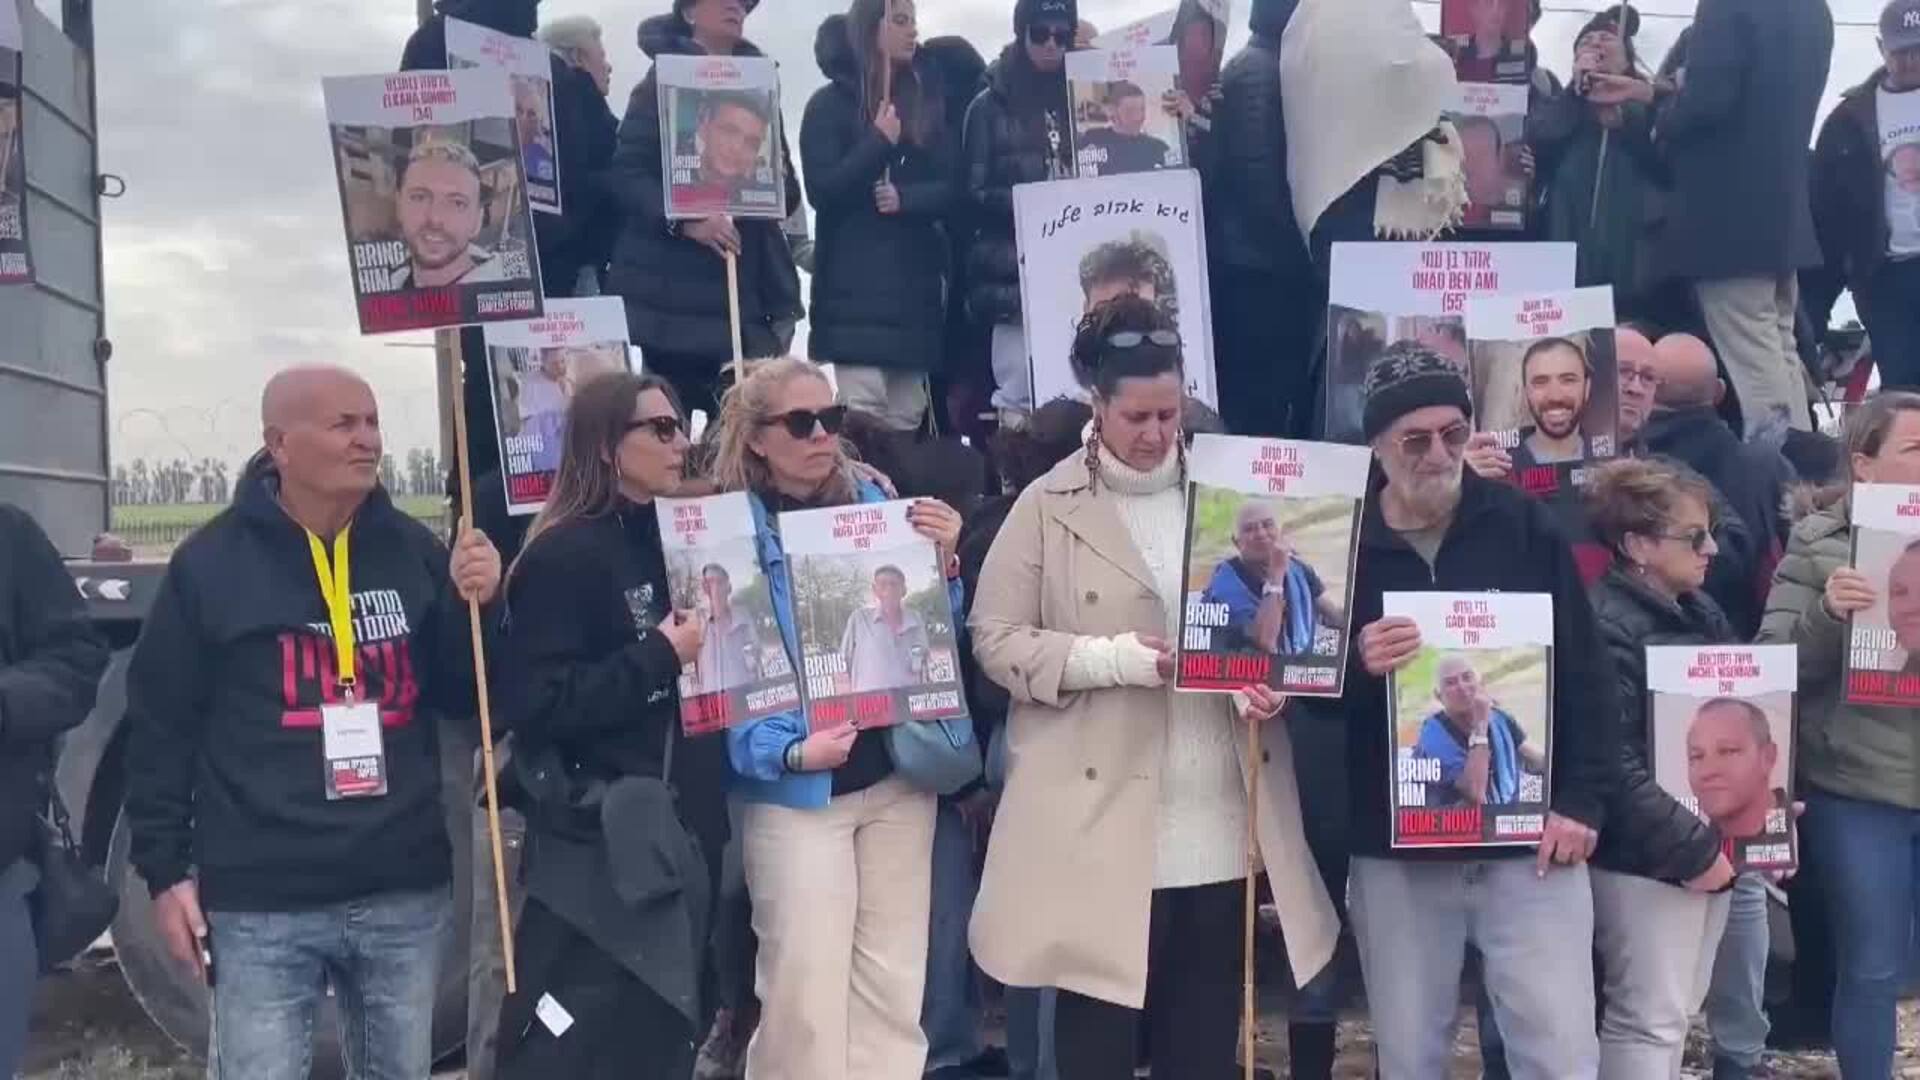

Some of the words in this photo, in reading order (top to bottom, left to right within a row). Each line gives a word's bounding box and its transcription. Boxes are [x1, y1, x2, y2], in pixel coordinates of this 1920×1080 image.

[1093, 199, 1144, 217] אהוב
[354, 241, 405, 268] BRING
[1421, 251, 1443, 268] עמי
[1447, 251, 1458, 270] בן
[1464, 251, 1491, 269] אוהד
[358, 267, 391, 294] HIM
[1413, 272, 1446, 289] OHAD
[1449, 272, 1472, 289] BEN
[1475, 272, 1499, 289] AMI
[505, 432, 545, 455] BRING
[1490, 430, 1520, 449] RING
[508, 454, 533, 475] HIM
[1251, 461, 1273, 475] GADI
[1275, 463, 1305, 478] MOSES
[350, 589, 403, 617] מחזירי
[1185, 602, 1230, 627] BRING
[363, 613, 411, 641] אותם
[1445, 615, 1466, 629] GADI
[1468, 614, 1497, 629] MOSES
[1184, 626, 1212, 651] HIM
[1850, 628, 1897, 649] BRING
[804, 651, 847, 677] BRING
[1183, 654, 1222, 678] HOME
[1226, 655, 1270, 680] NOW!
[1850, 649, 1878, 670] HIM
[807, 675, 835, 700] HIM
[1849, 673, 1890, 695] HOME
[1398, 757, 1441, 782] BRING
[1398, 782, 1426, 807] HIM
[1399, 809, 1439, 834] HOME
[1442, 806, 1482, 834] NOW!
